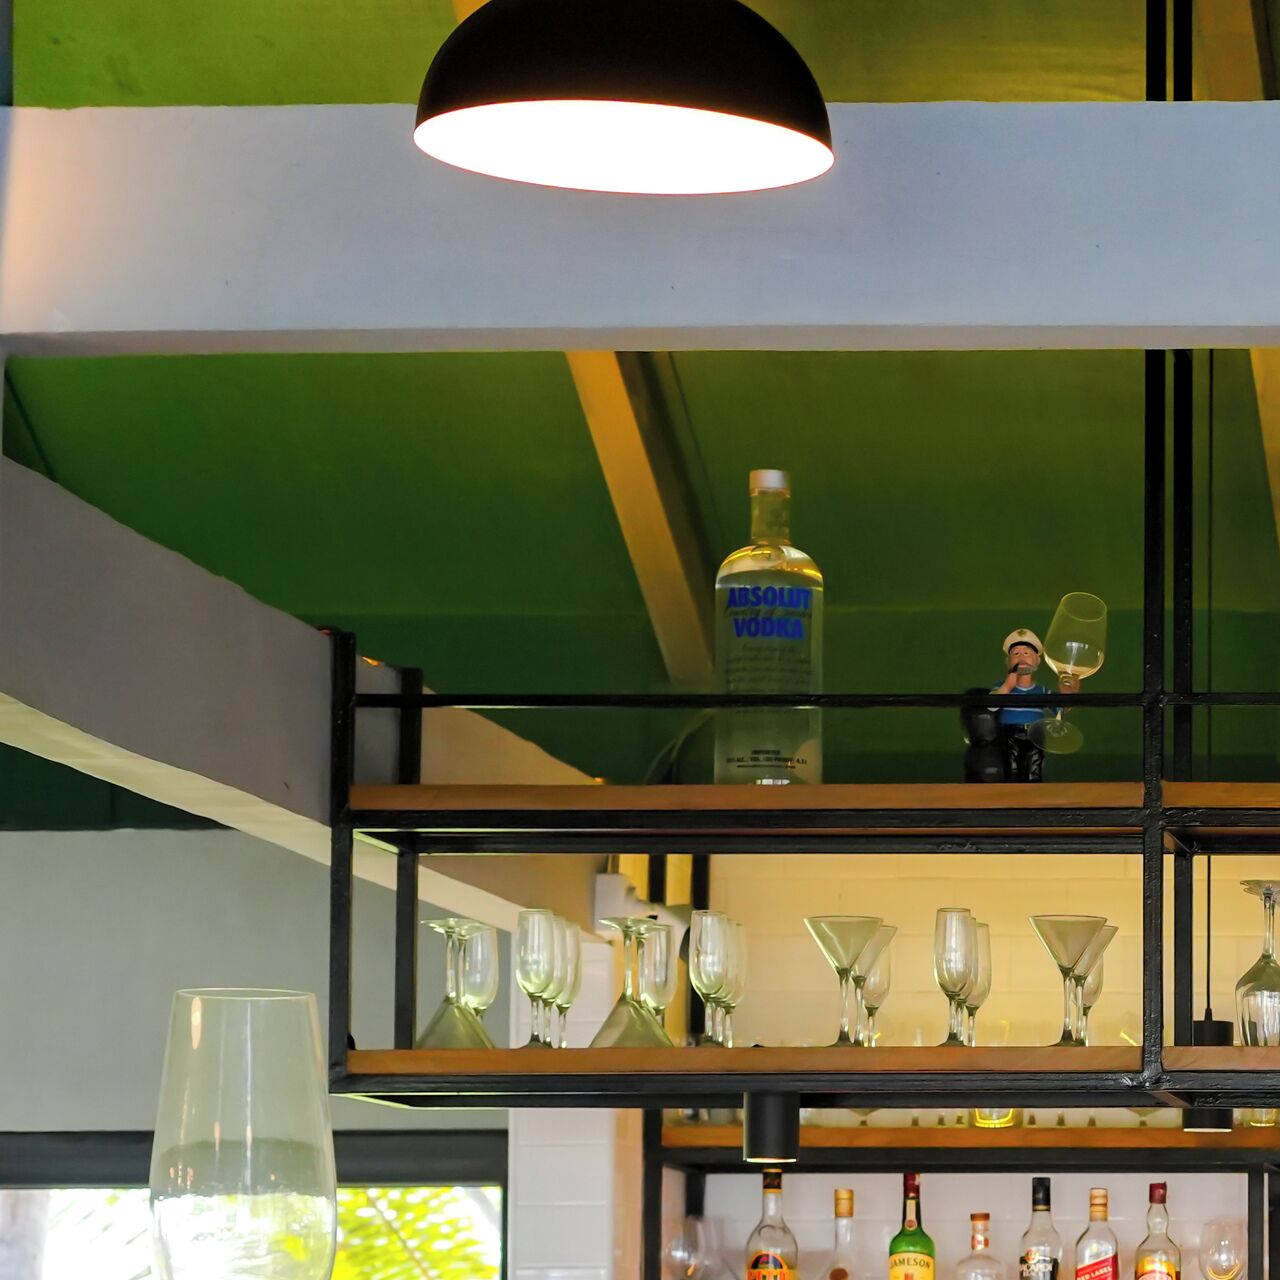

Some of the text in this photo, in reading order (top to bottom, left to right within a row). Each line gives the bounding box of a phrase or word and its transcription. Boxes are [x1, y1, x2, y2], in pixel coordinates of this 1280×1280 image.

[727, 586, 812, 609] ABSOLUT
[733, 617, 804, 639] VODKA
[890, 1256, 931, 1270] JAMESON
[1092, 1265, 1113, 1280] LABEL
